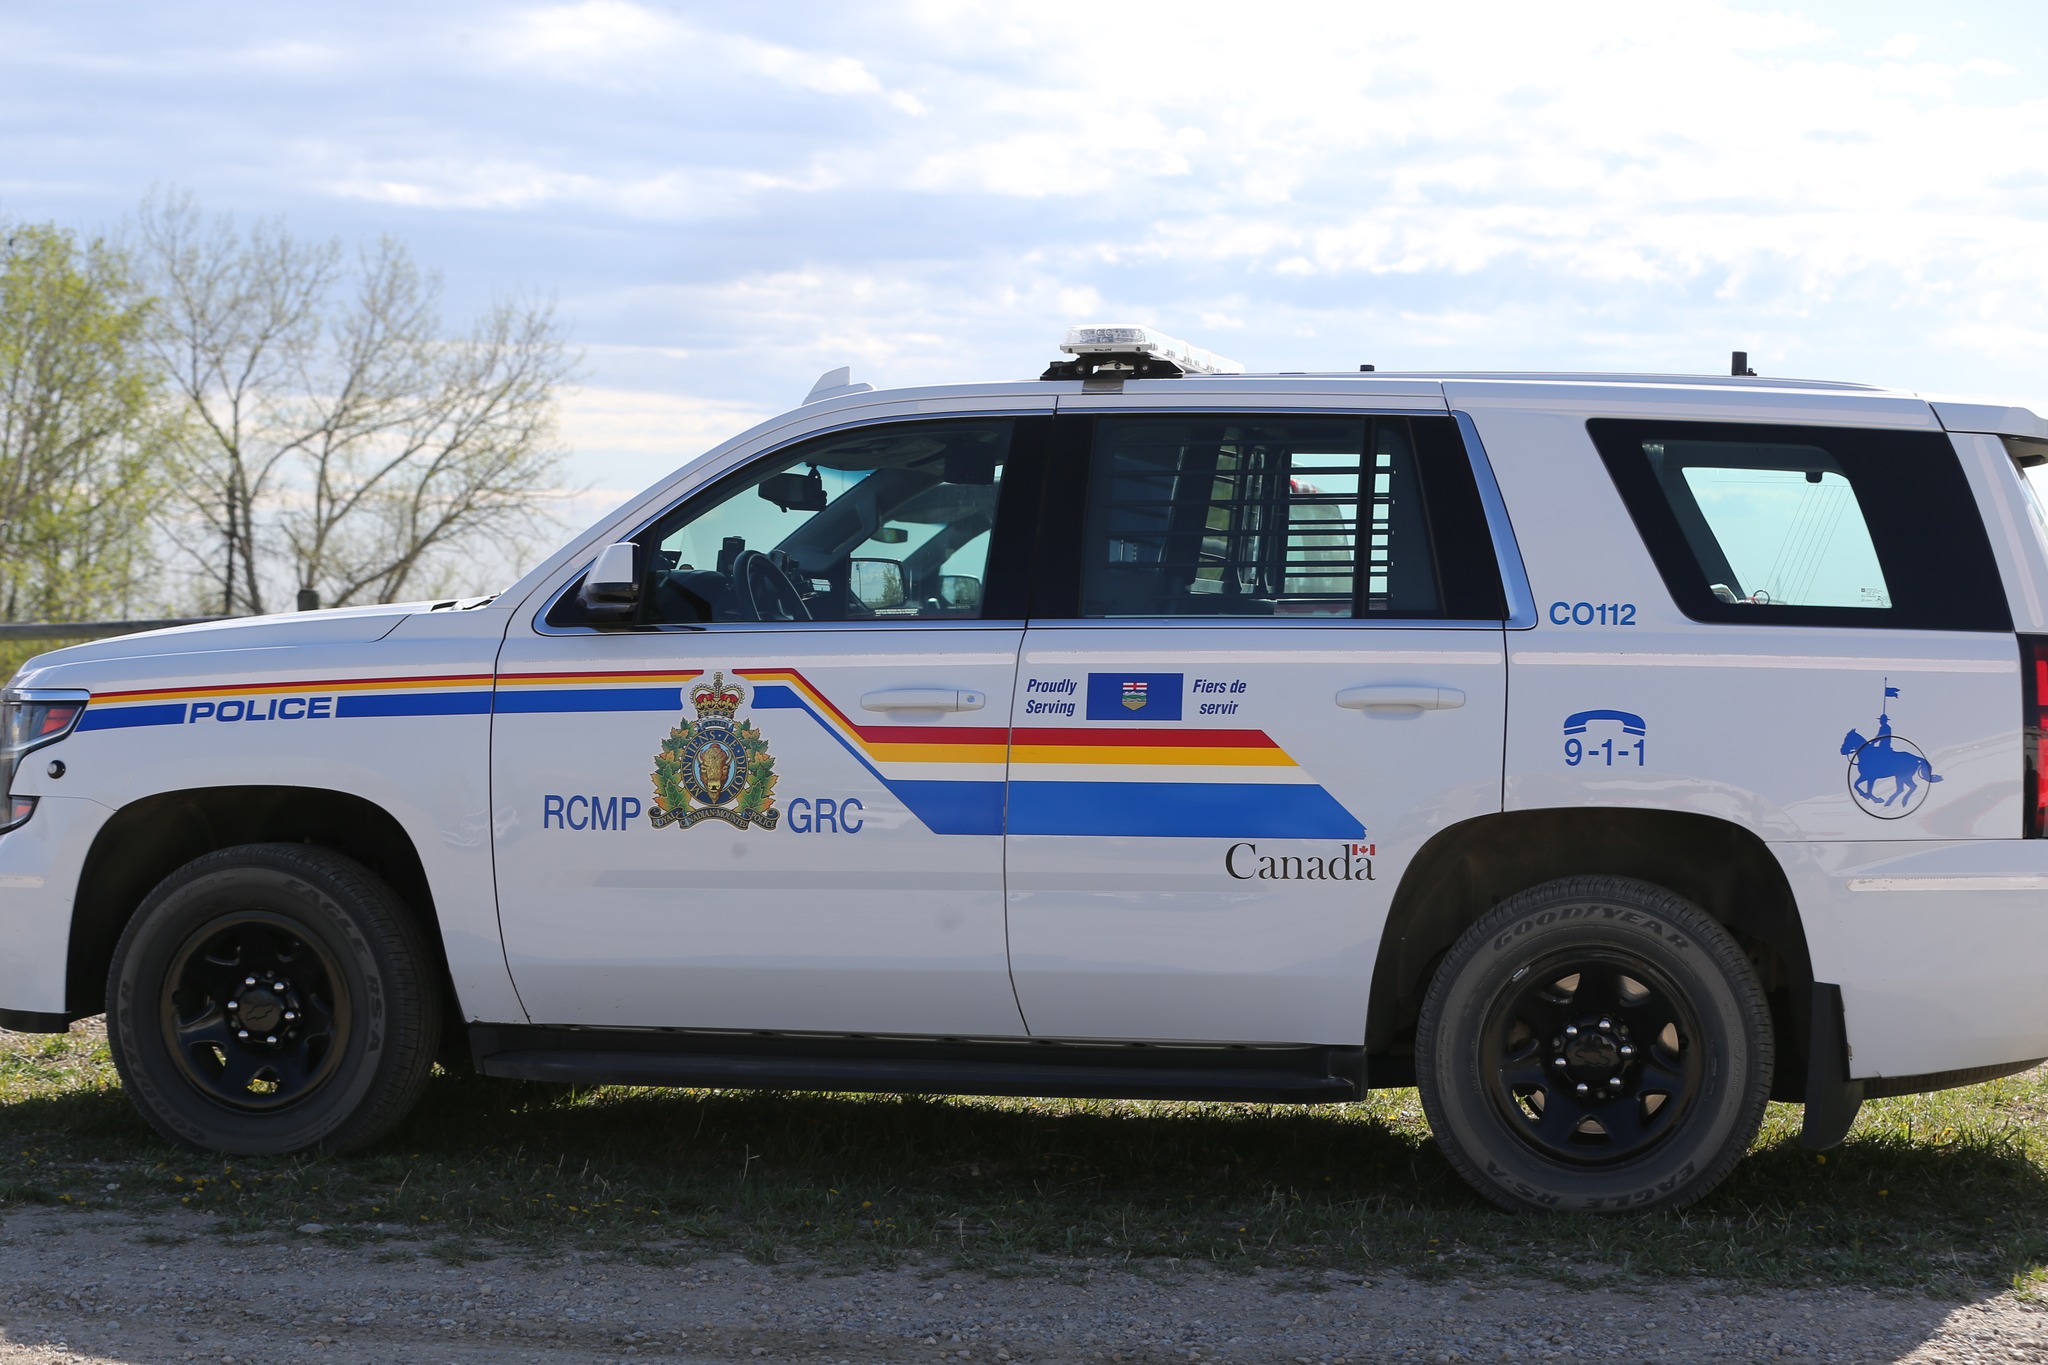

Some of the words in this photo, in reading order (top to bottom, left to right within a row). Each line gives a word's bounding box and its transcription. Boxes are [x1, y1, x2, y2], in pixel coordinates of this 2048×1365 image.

[1549, 602, 1636, 626] CO112
[1026, 679, 1078, 695] Proudly
[1193, 679, 1226, 693] Fiers
[1230, 679, 1247, 694] de
[189, 697, 332, 723] POLICE
[1026, 699, 1076, 717] Serving
[1199, 700, 1239, 715] servir
[702, 720, 730, 729] CANADA
[725, 733, 737, 748] LE
[1564, 738, 1645, 767] 9-1-1
[682, 730, 716, 797] MAINTIENS
[729, 755, 746, 799] DROIT
[543, 795, 641, 831] RCMP
[653, 812, 676, 827] ROYAL
[750, 812, 775, 828] POLICE
[787, 797, 864, 834] GRC
[1225, 842, 1377, 881] Canada
[283, 880, 369, 955] EAGLE
[1493, 905, 1689, 951] GOODYEAR
[120, 980, 207, 1141] GOODYEAR
[1582, 1160, 1695, 1209] EAGLE
